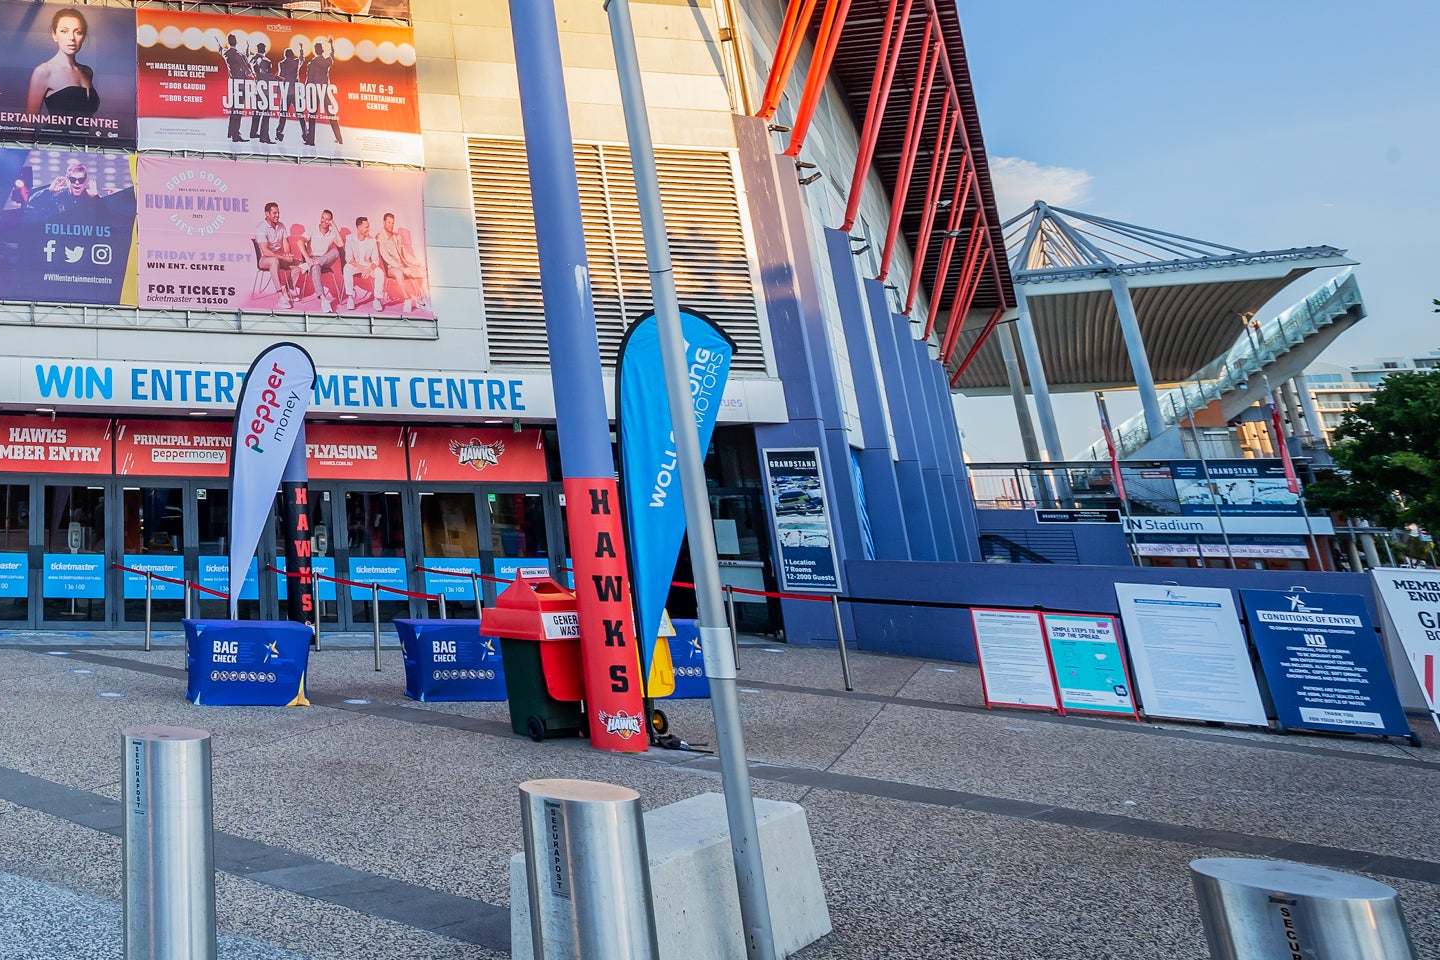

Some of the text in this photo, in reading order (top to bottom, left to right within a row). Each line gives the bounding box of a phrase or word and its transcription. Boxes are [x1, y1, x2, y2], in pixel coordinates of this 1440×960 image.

[154, 62, 186, 71] MARSHALL
[187, 64, 219, 72] BRICKMAN
[169, 82, 182, 90] BOB
[183, 83, 206, 91] GAUDIO
[359, 83, 394, 95] MAY 6-9
[222, 78, 339, 115] JERSEY BOYS
[348, 92, 406, 104] WIN ENTERTAINMENT
[366, 103, 389, 111] CENTRE
[76, 115, 120, 129] CENTRE
[166, 170, 228, 192] GOOD GOOD
[145, 193, 249, 213] HUMAN NATURE
[45, 223, 111, 238] FOLLOW US
[170, 213, 225, 236] LIFE TOUR
[147, 250, 252, 262] FRIDAY 17 SEPT
[43, 273, 113, 285] #WINentertainmentcentre
[148, 284, 236, 296] FOR TICKETS
[147, 295, 192, 303] ticketmaster
[35, 364, 113, 400] WIN
[409, 377, 526, 411] CENTRE
[696, 352, 724, 428] MOTORS
[245, 362, 286, 454] pepper
[274, 391, 300, 442] money
[9, 427, 67, 444] HAWKS
[133, 434, 192, 447] PRINCIPAL
[48, 446, 102, 462] ENTRY
[152, 449, 225, 462] peppermoney
[458, 447, 498, 465] HAWKS
[769, 460, 817, 468] GRANDSTAND
[1207, 467, 1258, 475] GRANDSTAND
[1145, 519, 1204, 531] Stadium
[589, 488, 630, 693] HAWKS
[1262, 613, 1314, 623] CONDITIONS
[1328, 617, 1357, 625] ENTRY
[1303, 634, 1326, 645] NO
[213, 640, 238, 654] BAG
[432, 641, 456, 653] BAG
[212, 653, 237, 663] CHECK
[433, 654, 457, 662] CHECK
[606, 718, 642, 733] HAWKS
[550, 808, 563, 889] SECURAPOST
